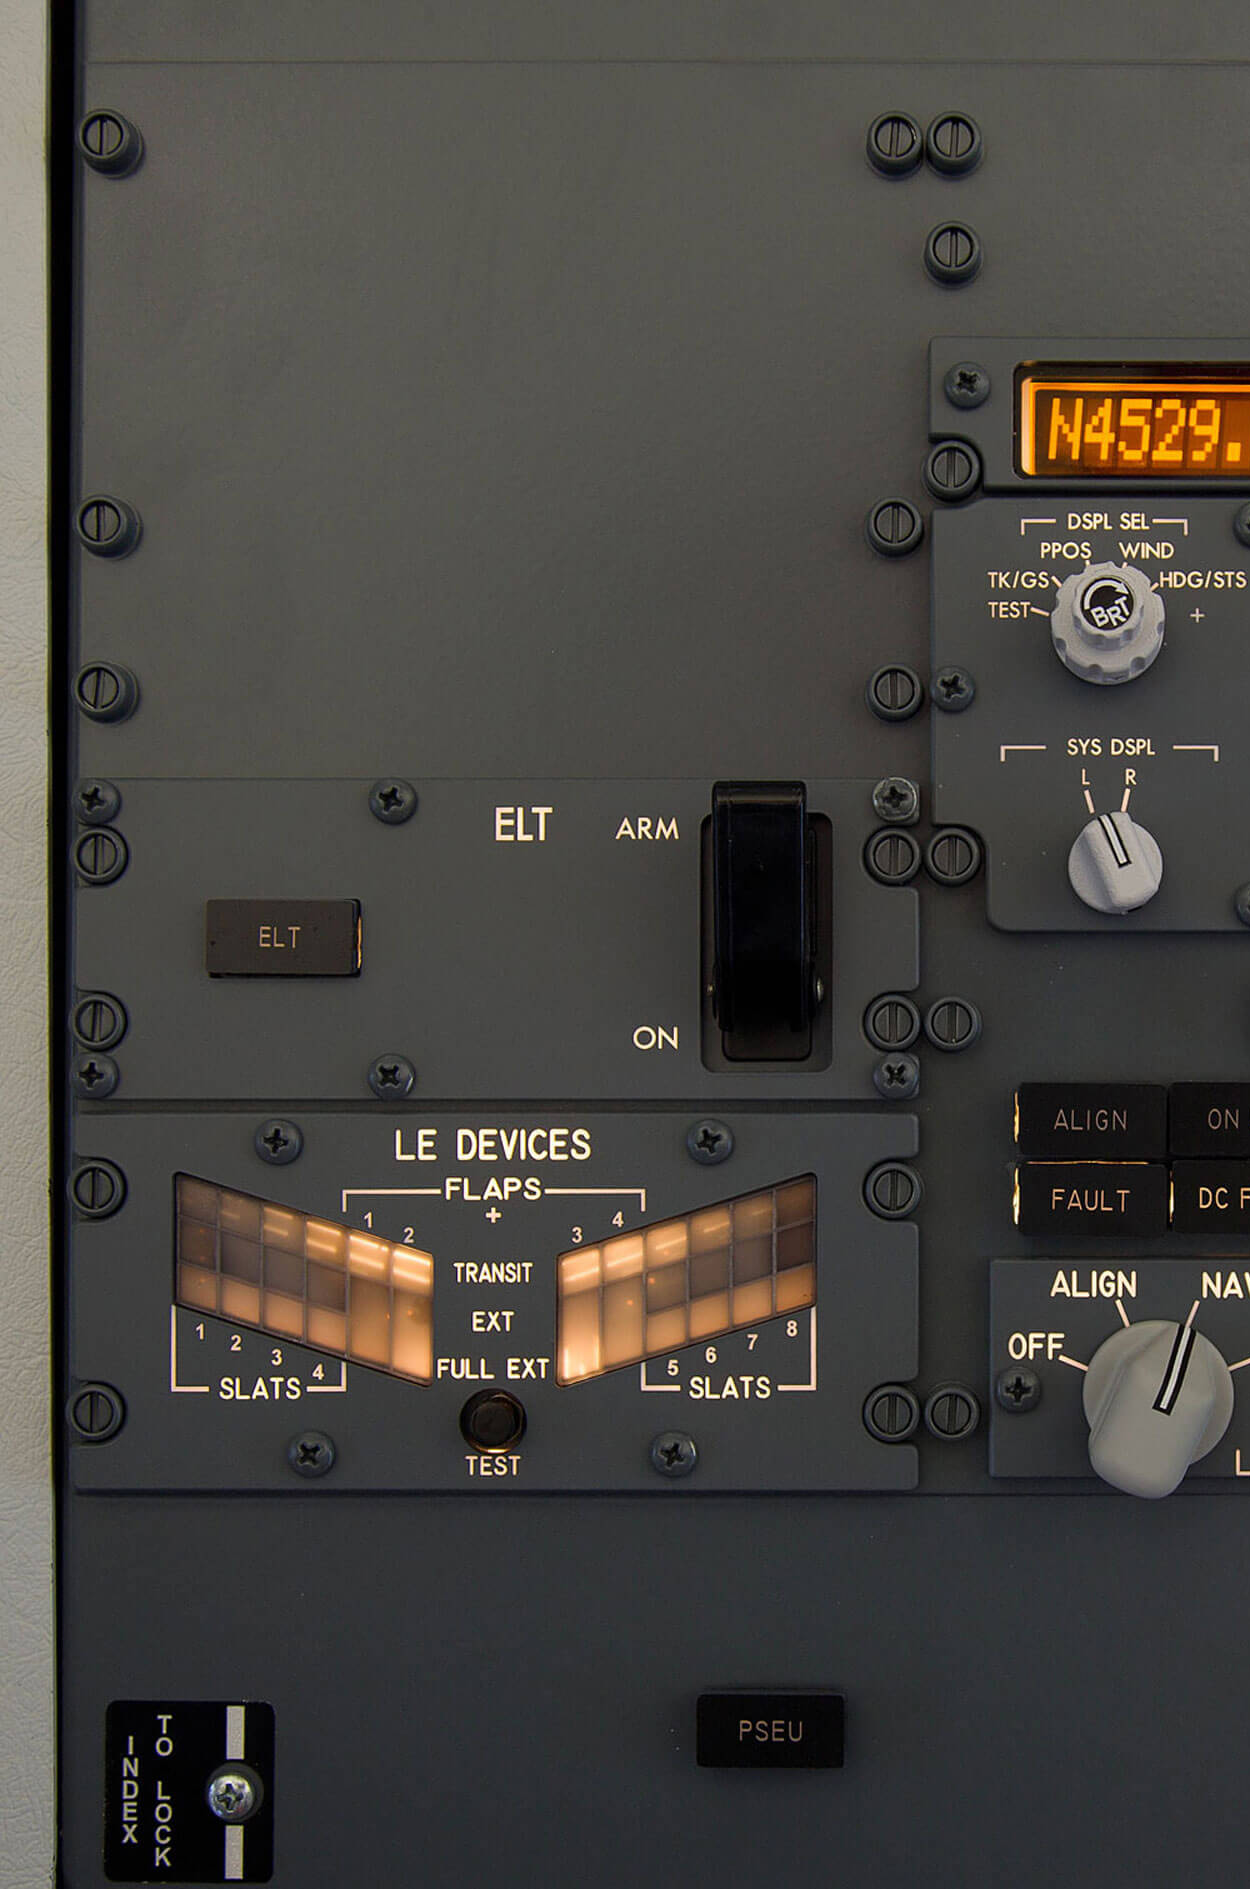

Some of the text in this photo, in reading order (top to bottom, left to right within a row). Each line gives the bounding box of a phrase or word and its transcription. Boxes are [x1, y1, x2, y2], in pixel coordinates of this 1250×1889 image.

[1068, 513, 1149, 530] DSPL SEL
[1041, 542, 1091, 559] PPOS
[1119, 542, 1174, 558] WIND
[988, 571, 1049, 588] TK/GS
[1160, 571, 1246, 588] HDG/STS
[988, 602, 1030, 618] TEST
[1091, 596, 1130, 628] BRT
[1068, 739, 1155, 755] SYS DSPL
[1082, 769, 1090, 785] L
[1126, 769, 1136, 785] R
[496, 807, 552, 841] ELT
[616, 818, 678, 839] ARM
[260, 926, 300, 948] ELT
[634, 1026, 678, 1049] ON
[1054, 1109, 1126, 1130] ALIGN
[1208, 1109, 1239, 1129] ON
[396, 1129, 590, 1160] LE DEVICES
[446, 1178, 541, 1200] FLAPS
[1200, 1187, 1228, 1208] DC
[1052, 1189, 1130, 1212] FAULT
[364, 1212, 371, 1228] 1
[613, 1212, 623, 1227] 4
[404, 1227, 413, 1243] 2
[572, 1227, 582, 1243] 3
[454, 1263, 532, 1283] TRANSIT
[1051, 1271, 1136, 1297] ALIGN
[473, 1311, 514, 1331] EXT
[787, 1320, 797, 1336] 8
[196, 1324, 203, 1339] 1
[231, 1335, 241, 1350] 2
[748, 1334, 758, 1350] 7
[1009, 1333, 1064, 1360] OFF
[272, 1349, 282, 1365] 3
[706, 1347, 716, 1363] 6
[313, 1364, 324, 1380] 4
[438, 1358, 549, 1379] FULL EXT
[668, 1360, 678, 1375] 5
[220, 1377, 300, 1399] SLATS
[689, 1376, 770, 1399] SLATS
[466, 1456, 520, 1475] TEST
[740, 1720, 802, 1742] PSEU
[122, 1736, 138, 1843] INDEX
[154, 1715, 173, 1866] TO LOCK
